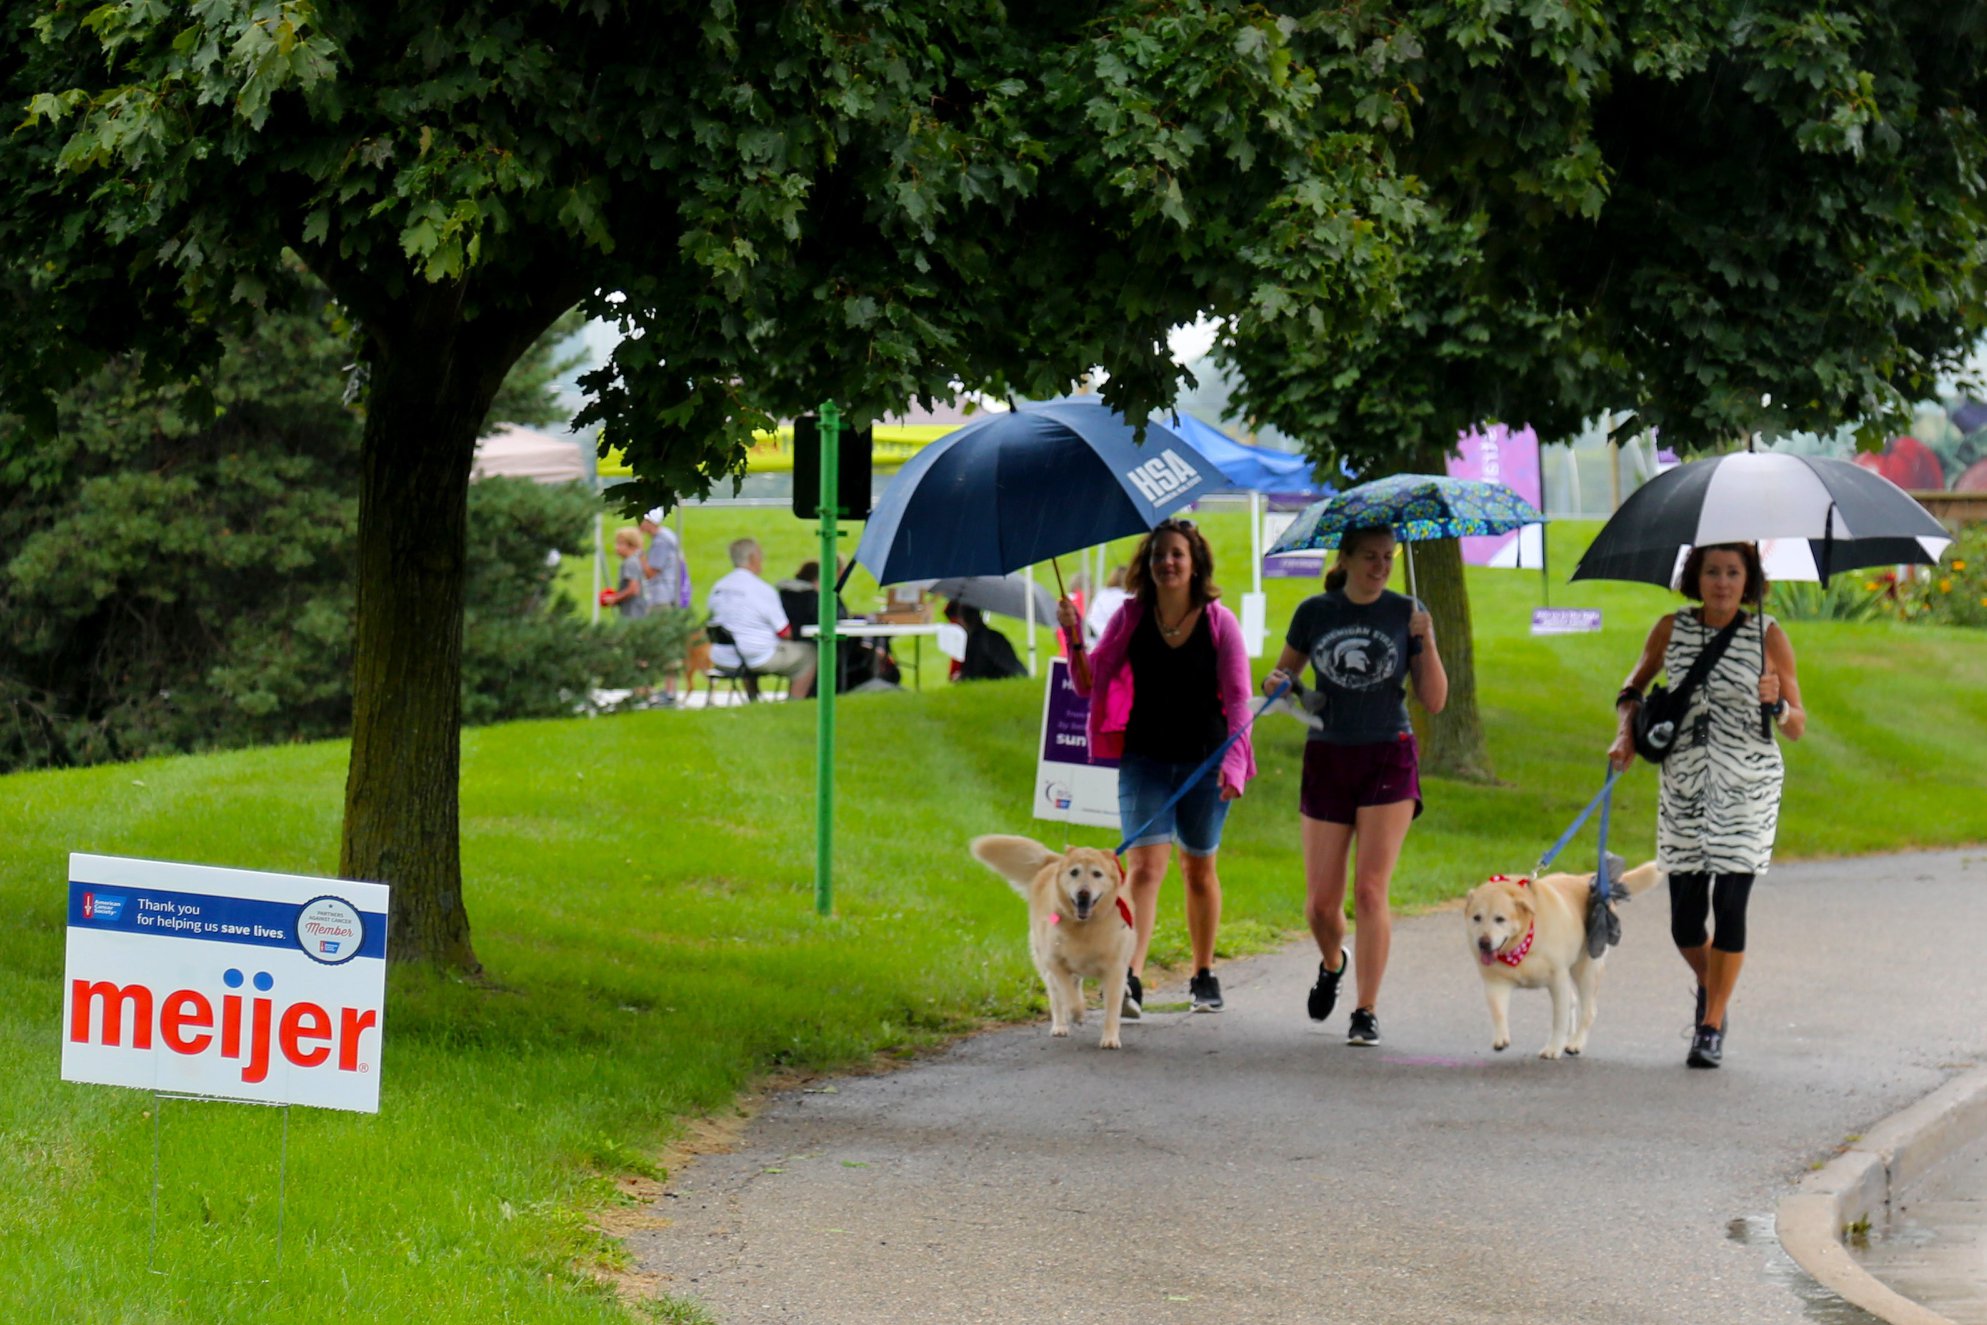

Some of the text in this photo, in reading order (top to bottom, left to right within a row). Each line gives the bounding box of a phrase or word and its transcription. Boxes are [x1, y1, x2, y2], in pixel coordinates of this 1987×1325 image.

[1126, 448, 1198, 502] HSA
[138, 898, 200, 916] Thank you
[137, 913, 286, 940] for helping us save lives.
[304, 921, 354, 938] Member
[70, 967, 377, 1084] meijer
